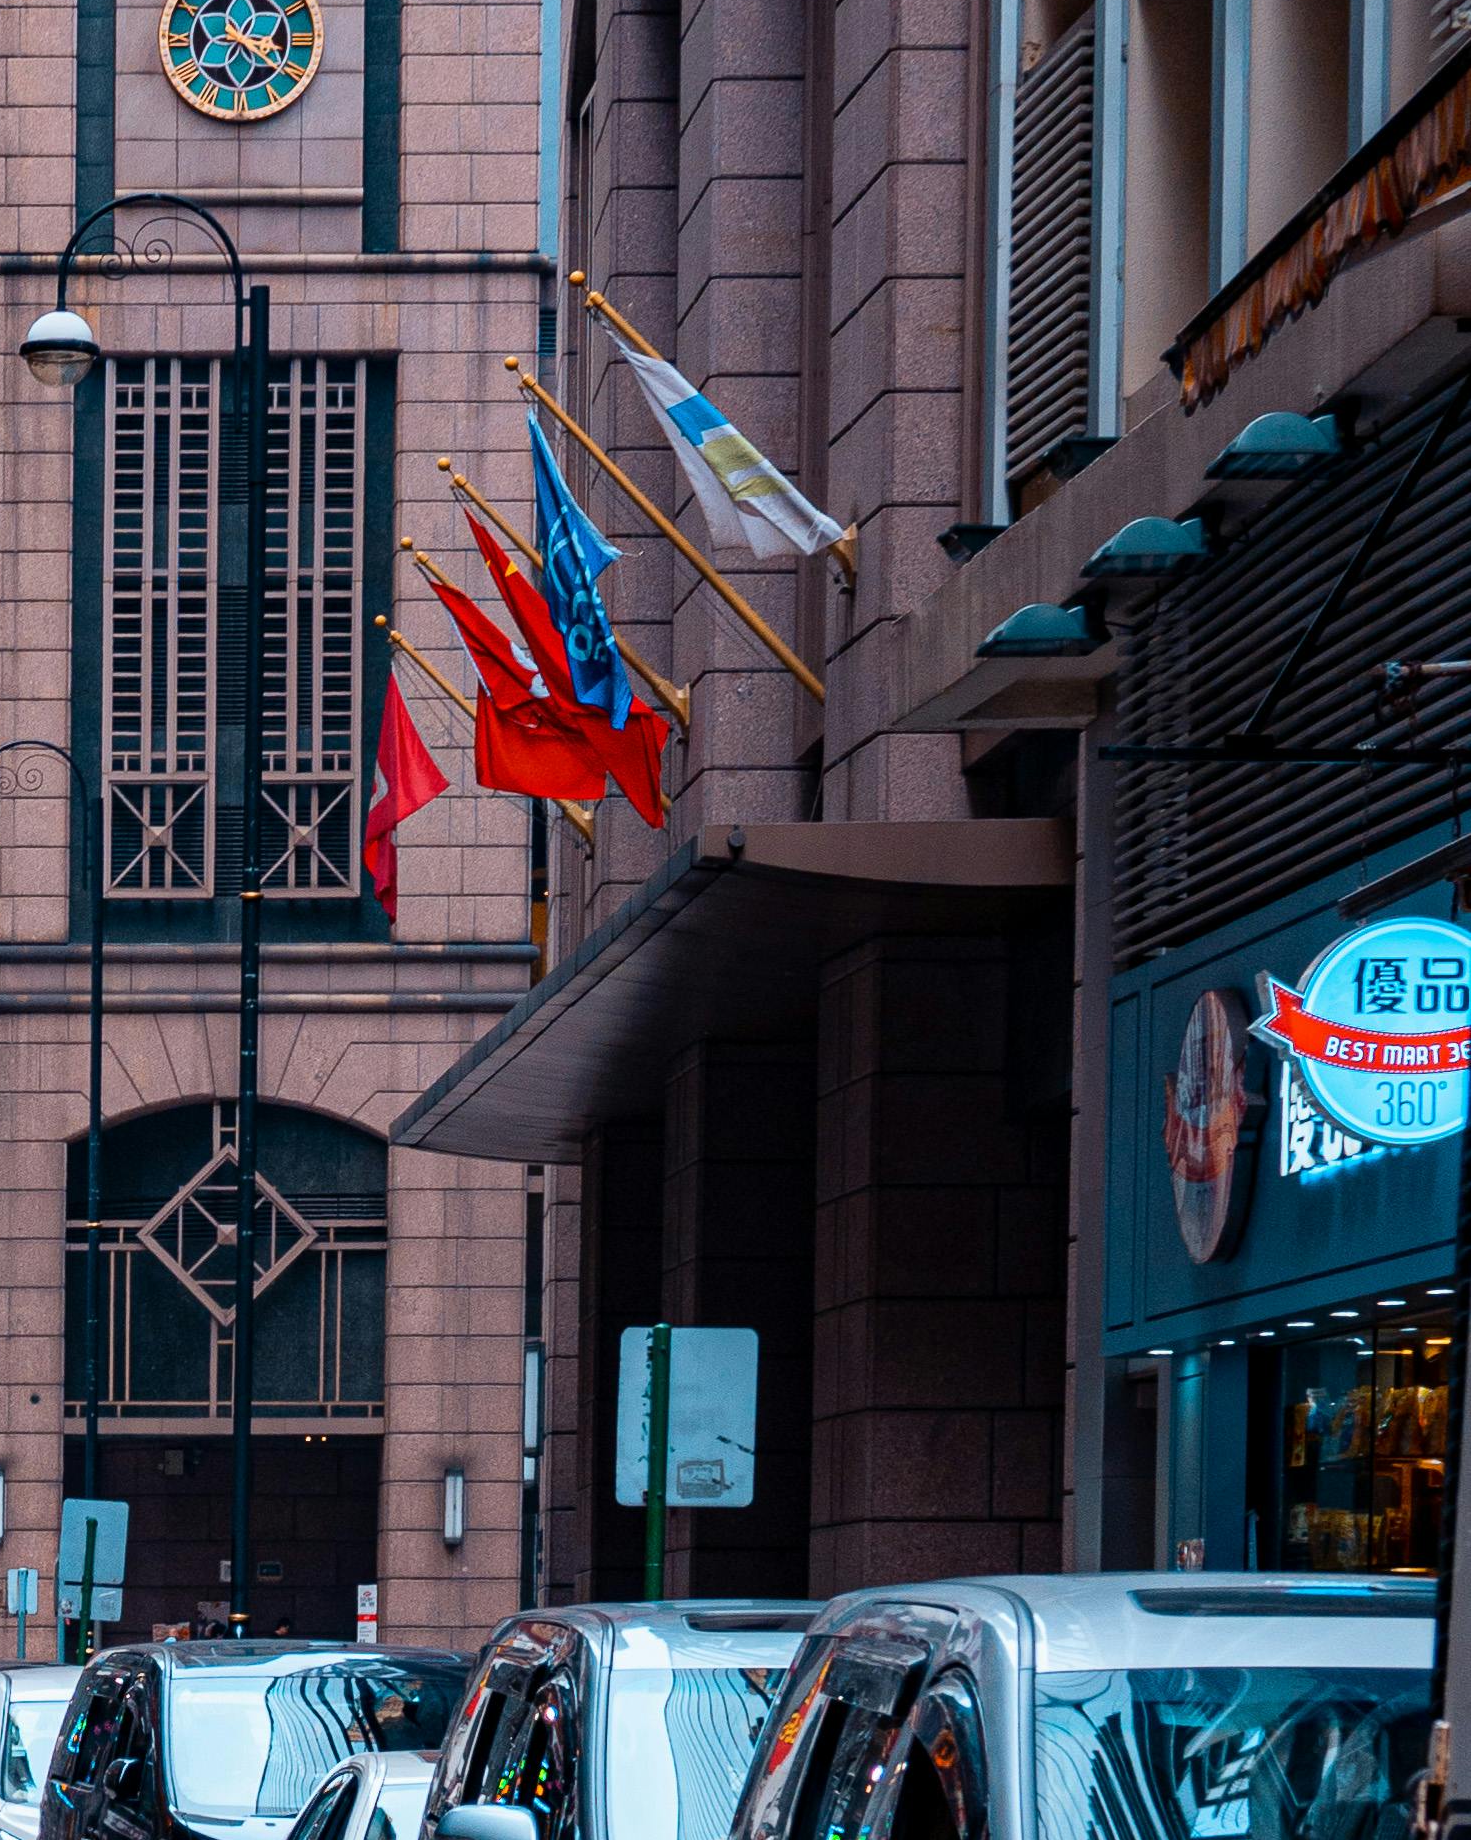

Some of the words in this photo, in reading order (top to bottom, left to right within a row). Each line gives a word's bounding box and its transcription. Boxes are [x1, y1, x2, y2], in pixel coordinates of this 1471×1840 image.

[1355, 957, 1470, 1015] 優品
[1325, 1035, 1377, 1061] BEST
[1382, 1042, 1442, 1065] MART
